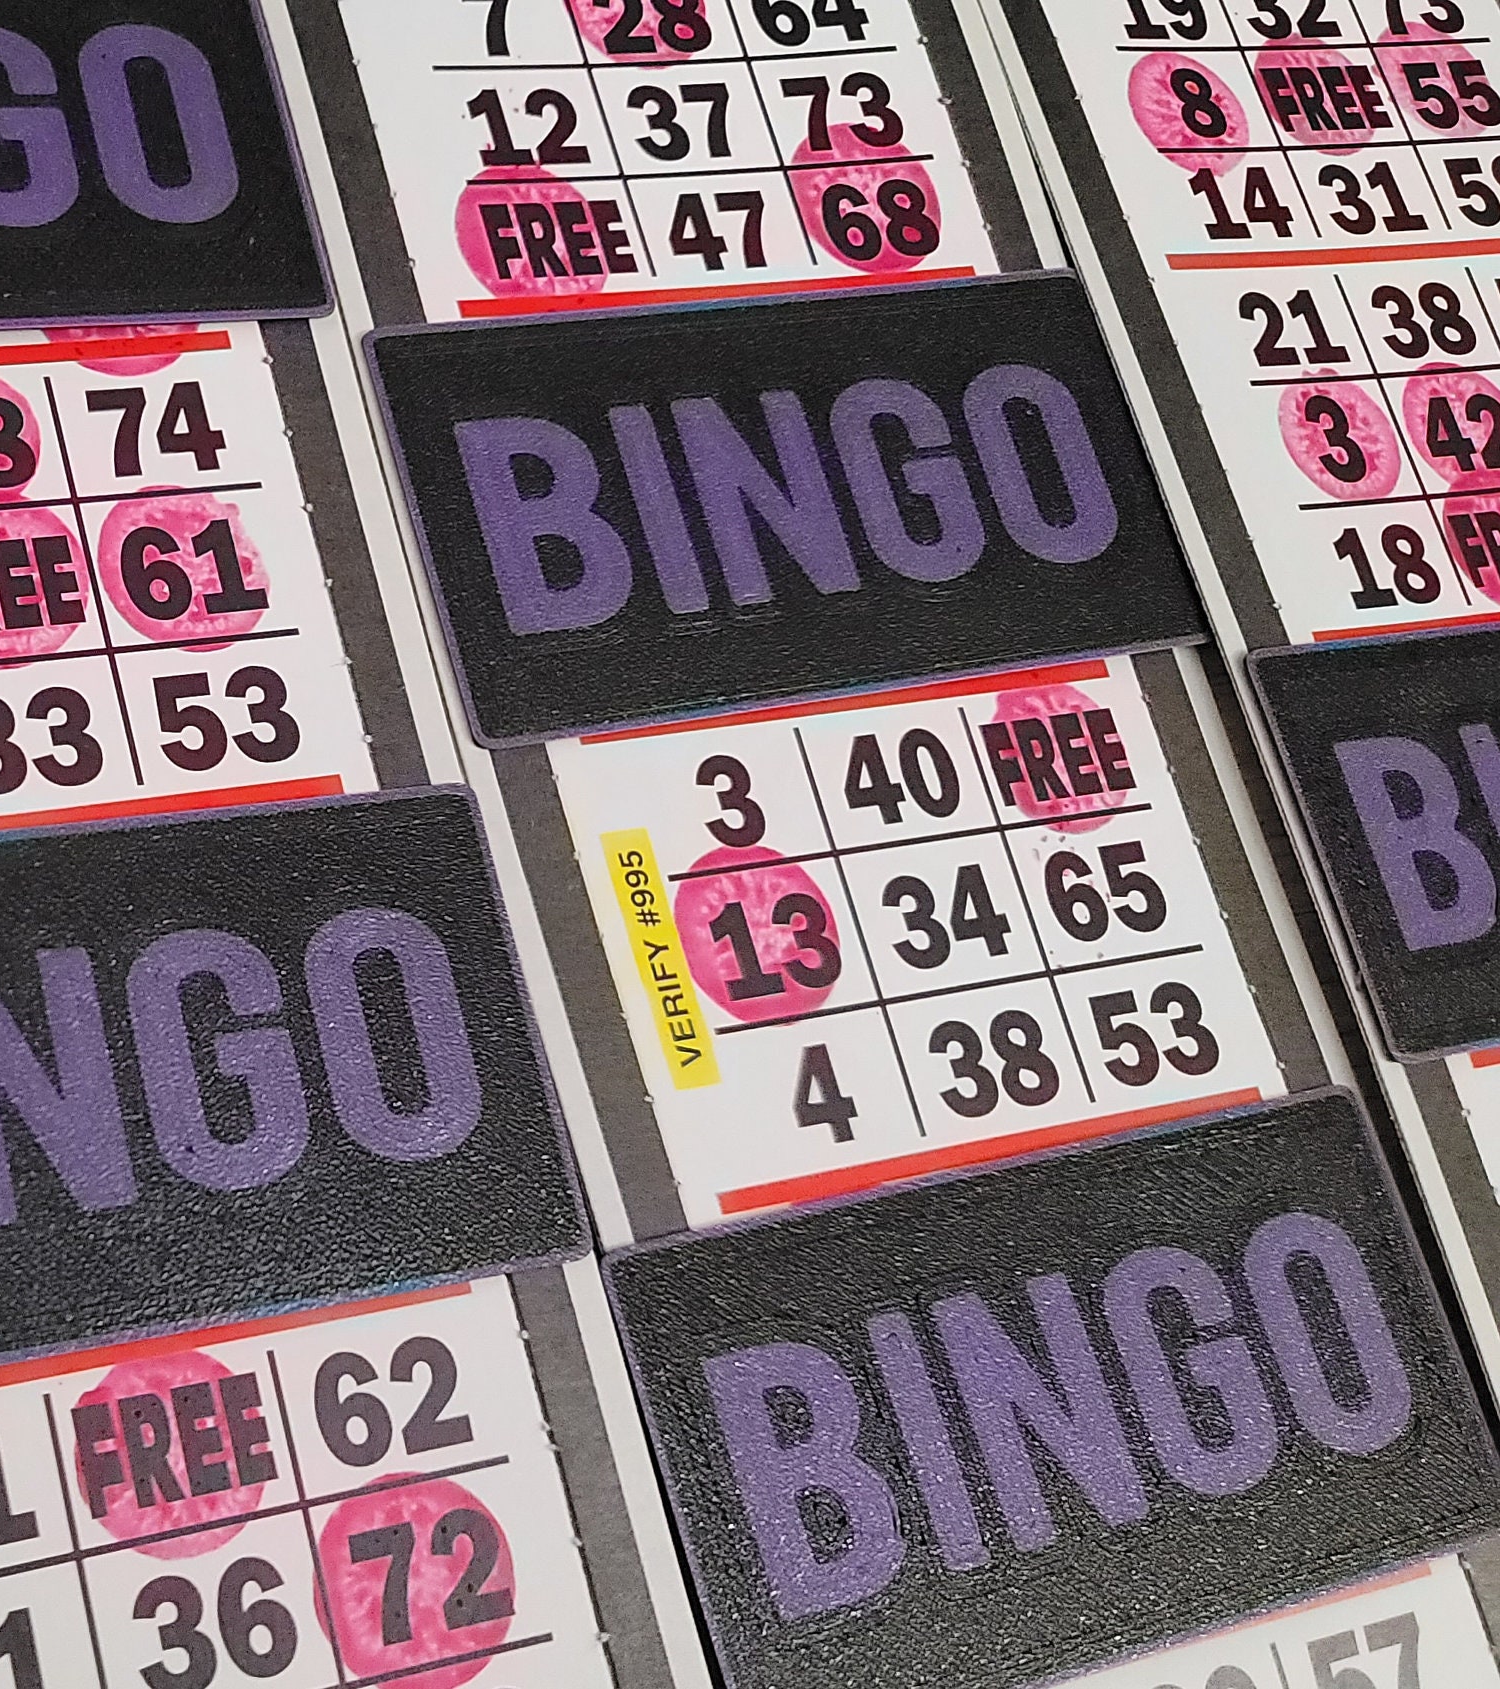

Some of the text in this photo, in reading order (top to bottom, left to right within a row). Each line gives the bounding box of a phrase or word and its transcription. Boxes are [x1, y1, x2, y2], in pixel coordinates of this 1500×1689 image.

[594, 0, 713, 55] 28
[751, 0, 870, 47] 64
[466, 71, 904, 167] 12 37 73
[1170, 59, 1500, 138] 8 FREE 55
[478, 179, 941, 280] FREE 47 68
[1188, 156, 1500, 239] 14 31 5
[1238, 289, 1351, 367] 21
[1371, 282, 1477, 358] 38
[86, 381, 227, 477] 74
[1304, 395, 1367, 483] 3
[453, 363, 1121, 635] BINGO
[119, 519, 269, 622] 61
[1333, 523, 1441, 609] 18
[152, 666, 301, 772] 53
[695, 707, 1136, 847] 3 40 FREE
[618, 849, 703, 1068] VERIFY #995
[709, 840, 1167, 1001] 13 34 65
[791, 982, 1220, 1144] 4 38 53
[71, 1372, 279, 1521] FREE
[315, 1336, 475, 1467] 62
[700, 1211, 1412, 1624] BINGO
[132, 1557, 298, 1689] 36
[347, 1507, 515, 1647] 72
